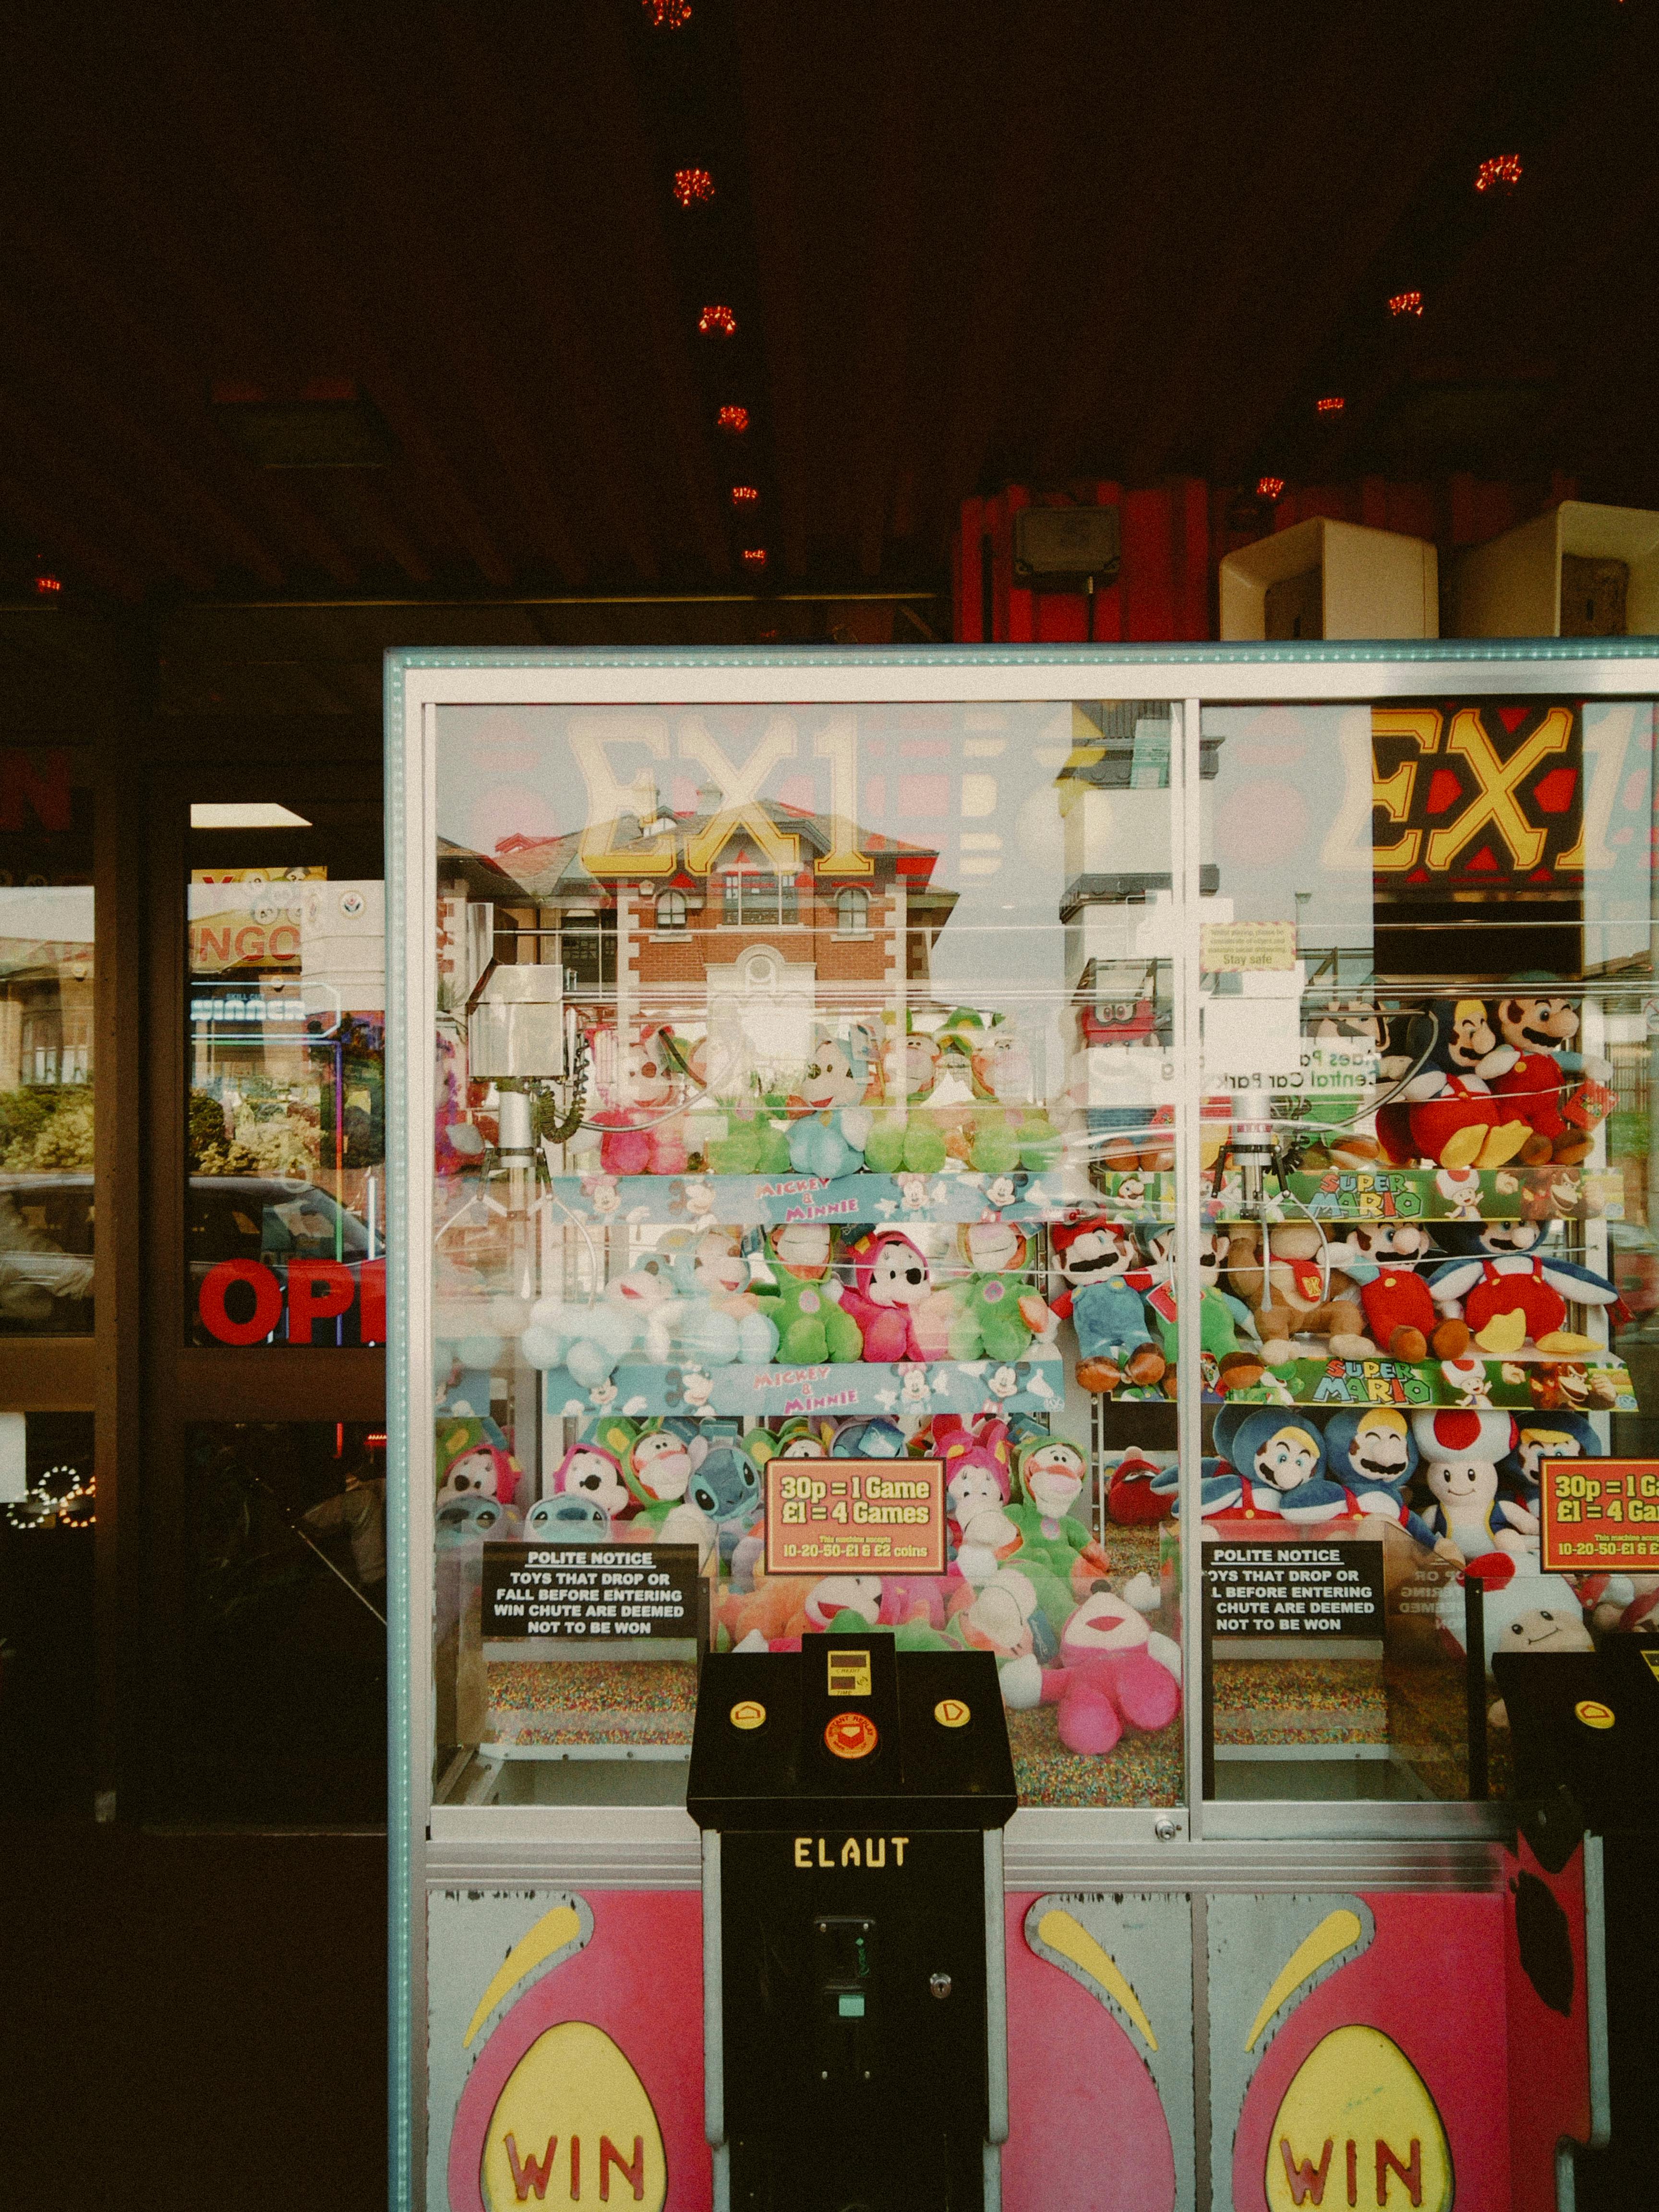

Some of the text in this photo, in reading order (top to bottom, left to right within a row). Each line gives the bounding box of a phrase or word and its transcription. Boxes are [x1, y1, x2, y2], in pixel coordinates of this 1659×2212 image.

[1224, 954, 1272, 966] Stay safe
[754, 1177, 830, 1199] MICKEY
[1320, 1173, 1407, 1193] SUPER
[786, 1199, 858, 1222] MINNIE
[1308, 1191, 1422, 1218] MARIO
[753, 1367, 830, 1390] MICKEY
[1325, 1359, 1415, 1380] SUPER
[1312, 1377, 1432, 1405] MARIO
[783, 1390, 857, 1415] MINNIE
[781, 1476, 930, 1504] 30p = 1 Game
[1555, 1474, 1601, 1503] 30p
[1606, 1481, 1622, 1493] =
[1626, 1475, 1636, 1497] 1
[782, 1501, 930, 1524] £1 = 4 Games
[1557, 1499, 1659, 1522] £1 = 4 Ga
[528, 1551, 652, 1565] POLITE NOTICE
[874, 1544, 891, 1558] £2
[894, 1544, 928, 1558] coins
[1214, 1550, 1340, 1562] POLITE NOTICE
[1559, 1542, 1635, 1555] 10-20-50-£1
[510, 1572, 670, 1585] TOYS THAT DROP OR
[1204, 1570, 1359, 1582] OYS THAT DROP OR
[496, 1588, 683, 1602] FALL BEFORE ENTERING
[1226, 1587, 1287, 1598] BEFORE
[1291, 1587, 1372, 1599] ENTERING
[494, 1604, 684, 1617] WIN CHUTE ARE DEEMED
[1216, 1602, 1375, 1614] CHUTE ARE DEEMED
[528, 1622, 651, 1634] NOT TO BE WON
[1216, 1619, 1341, 1631] NOT TO BE WON
[795, 1838, 909, 1867] ELAUT
[505, 2134, 644, 2202] WIN
[1280, 2139, 1422, 2207] WIN
